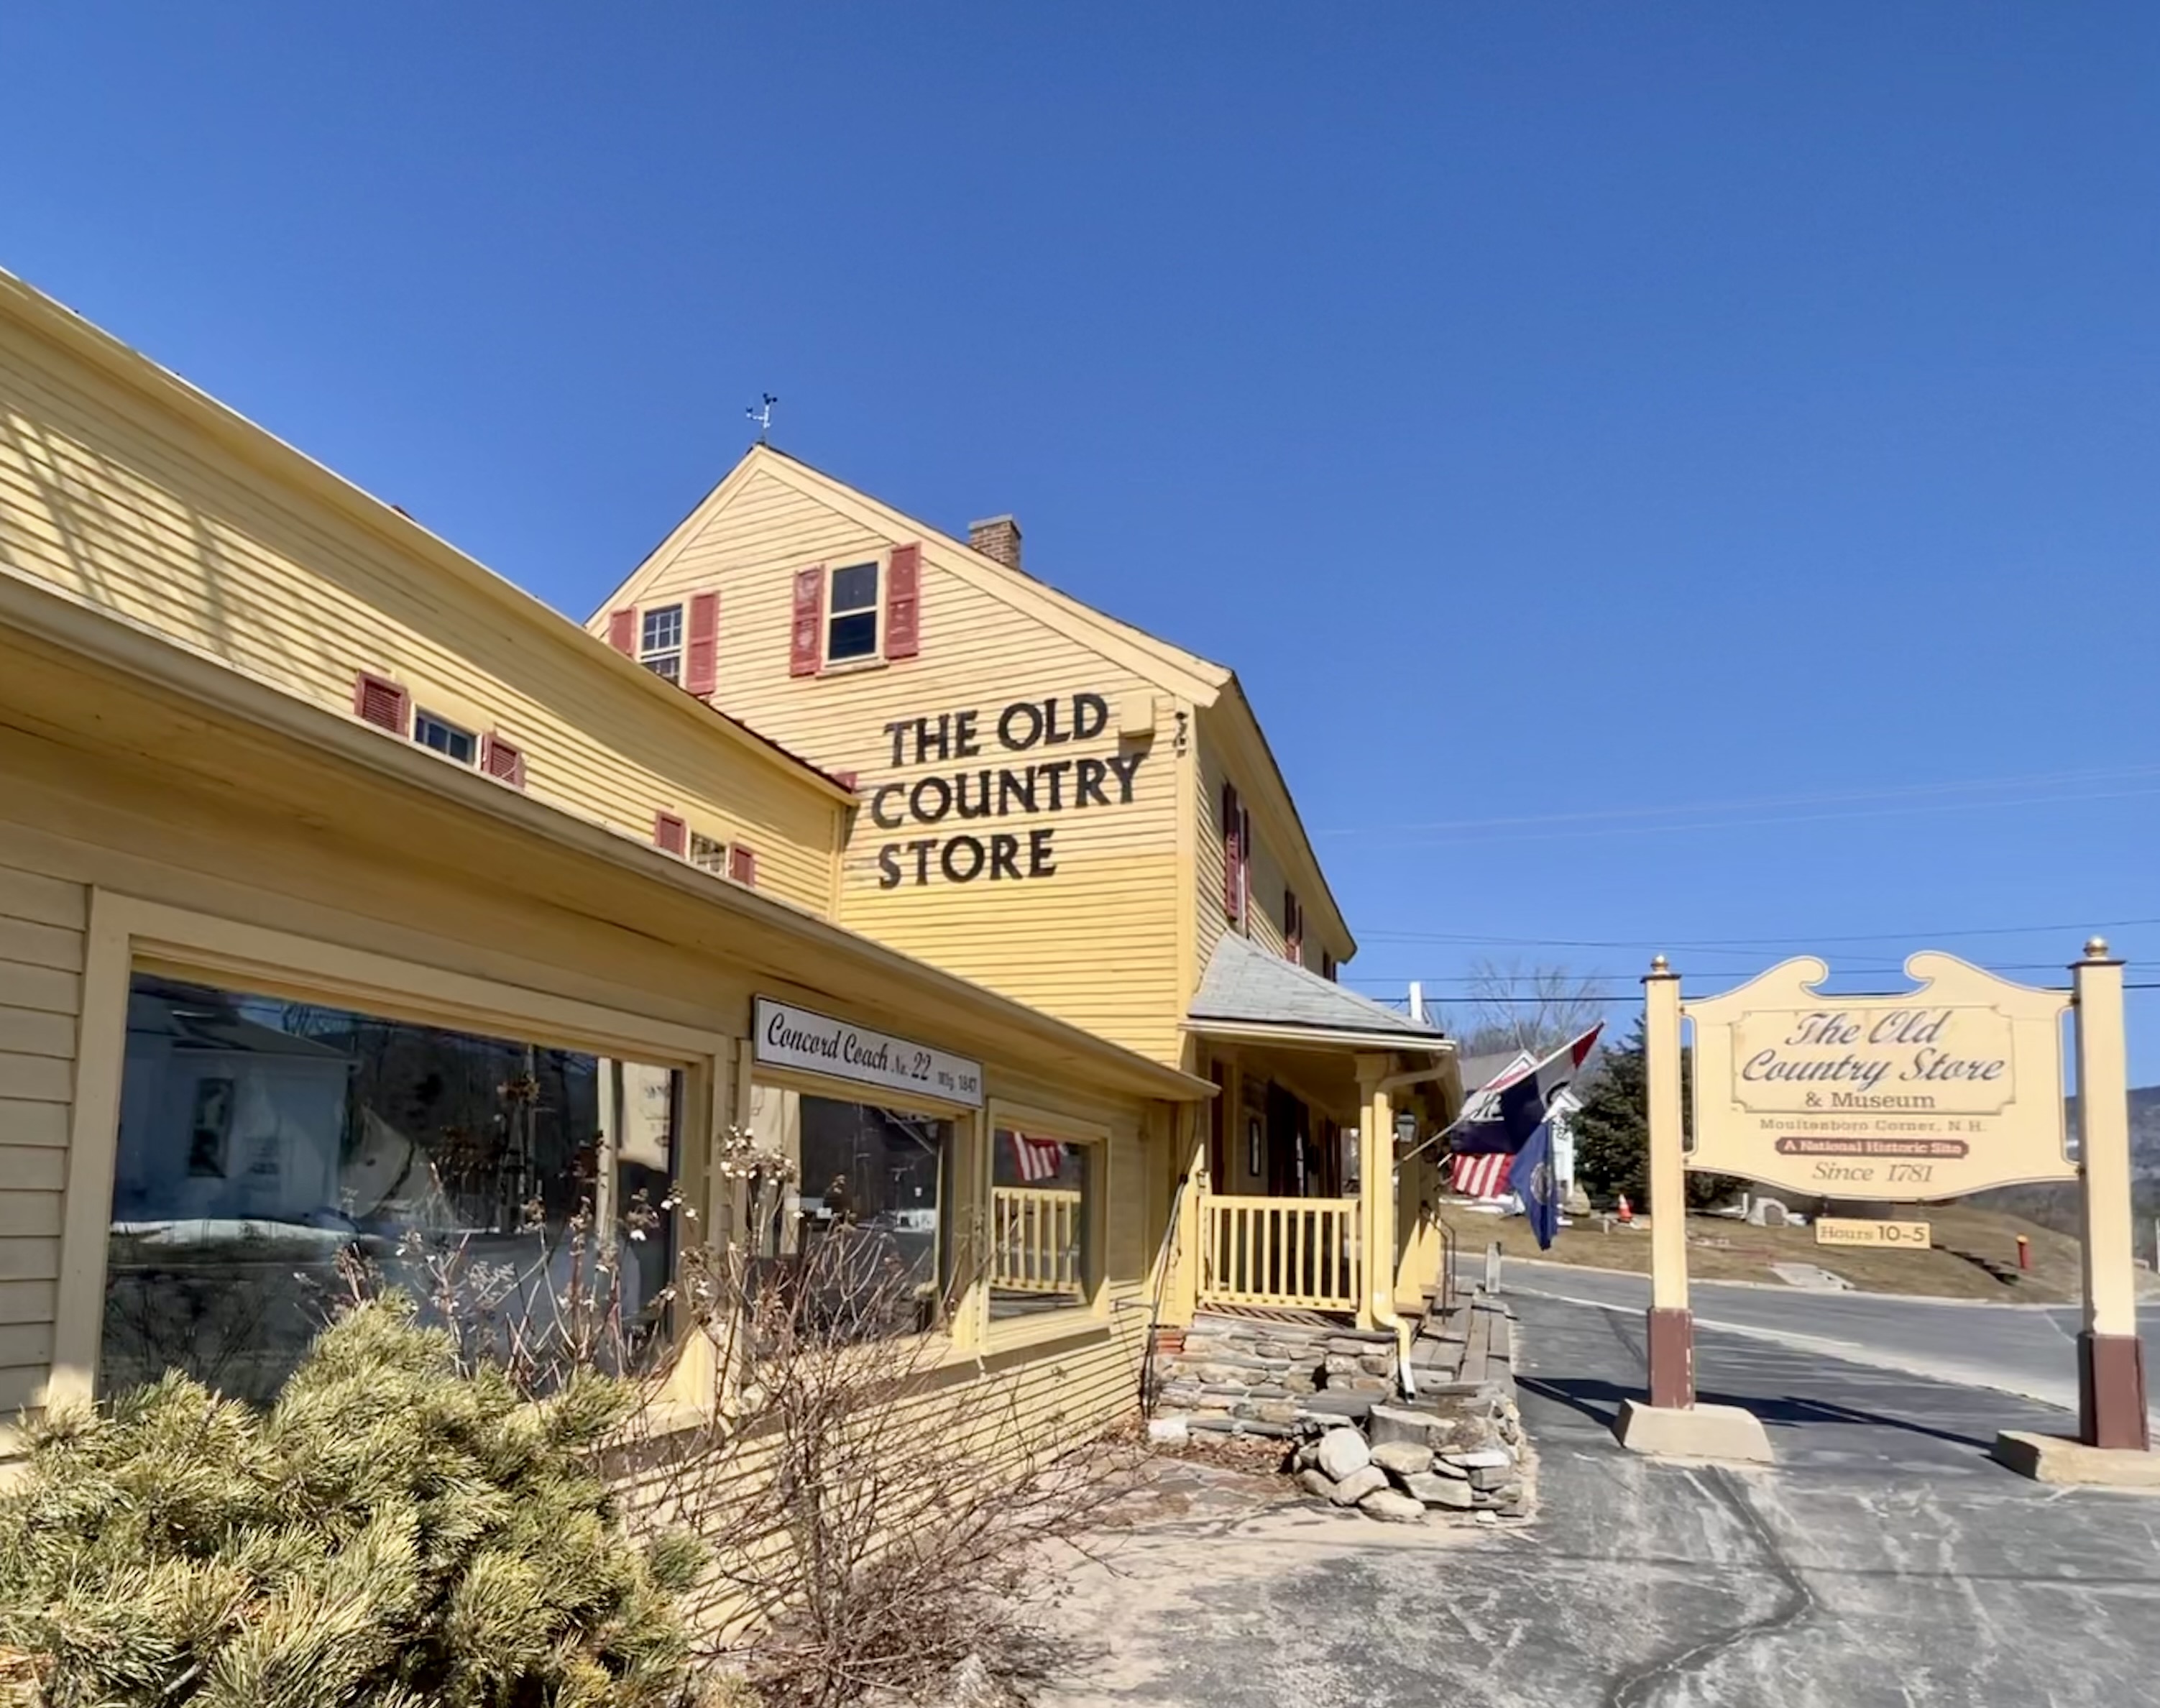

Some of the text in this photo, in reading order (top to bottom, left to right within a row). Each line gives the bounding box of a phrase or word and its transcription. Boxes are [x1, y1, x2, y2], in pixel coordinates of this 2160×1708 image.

[884, 693, 1109, 768] THE OLD
[872, 753, 1145, 829] COUNTRY
[878, 829, 1057, 890] STORE
[768, 1012, 842, 1060] Concord
[844, 1033, 888, 1072] Coach
[911, 1051, 932, 1080] 22
[1784, 1010, 1952, 1045] The Old
[1742, 1047, 2005, 1093] Country Store
[1805, 1092, 1936, 1109] & Museum
[1784, 1139, 1796, 1152] A
[1801, 1141, 1862, 1153] National
[1931, 1142, 1962, 1155] Site
[1812, 1160, 1934, 1184] Since 1781
[1819, 1224, 1926, 1243] Hours 10-5
